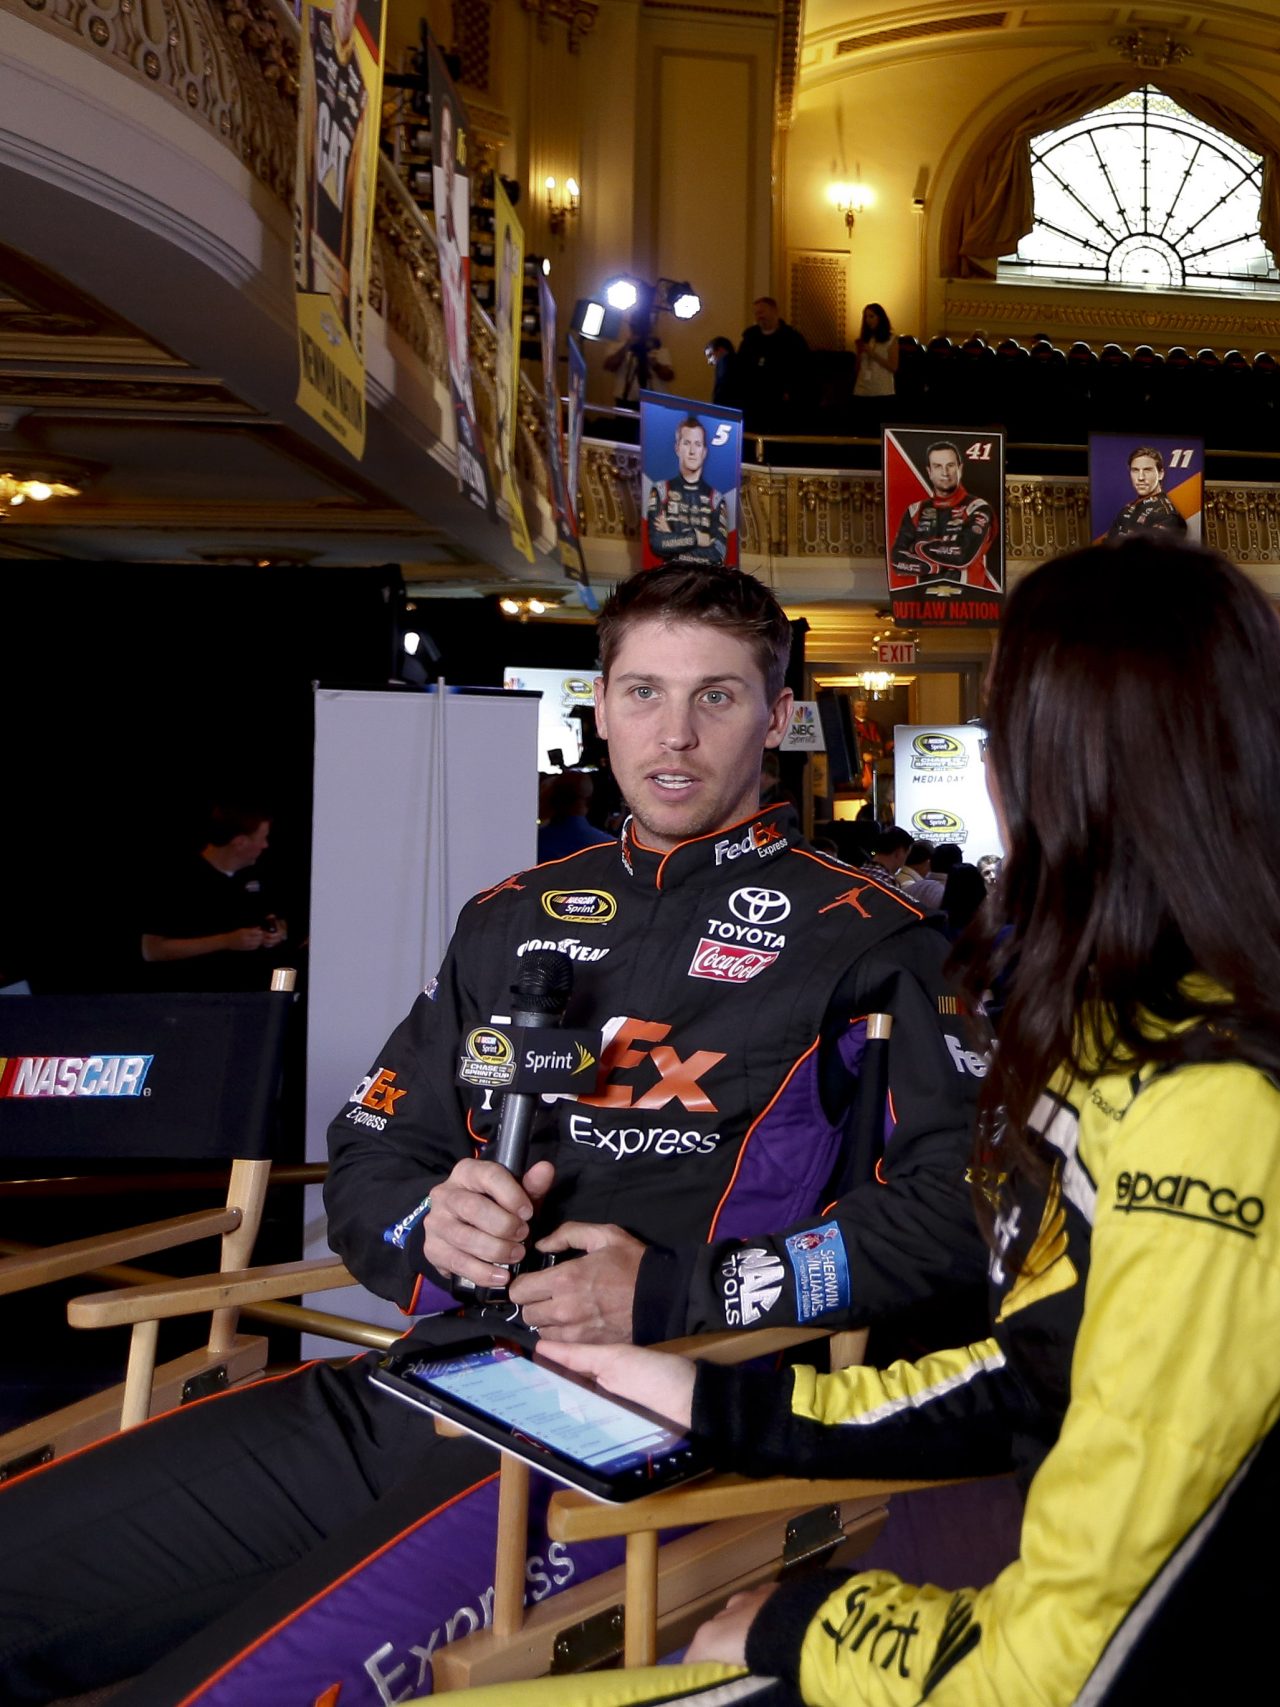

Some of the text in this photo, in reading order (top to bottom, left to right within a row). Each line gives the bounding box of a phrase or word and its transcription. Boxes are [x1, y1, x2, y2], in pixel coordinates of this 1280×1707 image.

[316, 102, 352, 213] CAT
[711, 424, 732, 446] 5
[965, 442, 993, 460] 41
[1169, 449, 1194, 468] 11
[893, 601, 999, 619] OUTLAW NATION
[880, 645, 913, 662] EXIT
[791, 725, 815, 735] NBC
[912, 775, 943, 783] MEDIA
[714, 822, 783, 866] FedEx
[757, 837, 788, 859] Express
[565, 896, 597, 904] NASCAR
[565, 904, 595, 914] Sprint
[707, 919, 786, 948] TOYOTA
[481, 1044, 498, 1054] Sprint
[464, 1068, 493, 1076] SPRINT
[493, 1071, 510, 1079] CUP
[469, 1063, 499, 1071] CHASE
[524, 1050, 573, 1074] Sprint
[12, 1057, 145, 1096] NASCAR
[349, 1066, 408, 1116] dEx
[346, 1106, 388, 1131] Express
[569, 1114, 721, 1161] Express
[1117, 1171, 1265, 1228] sparco
[722, 1252, 740, 1326] TOOLS
[737, 1248, 785, 1326] MAC
[820, 1249, 840, 1308] SHERWIN
[363, 1541, 575, 1707] Exprss
